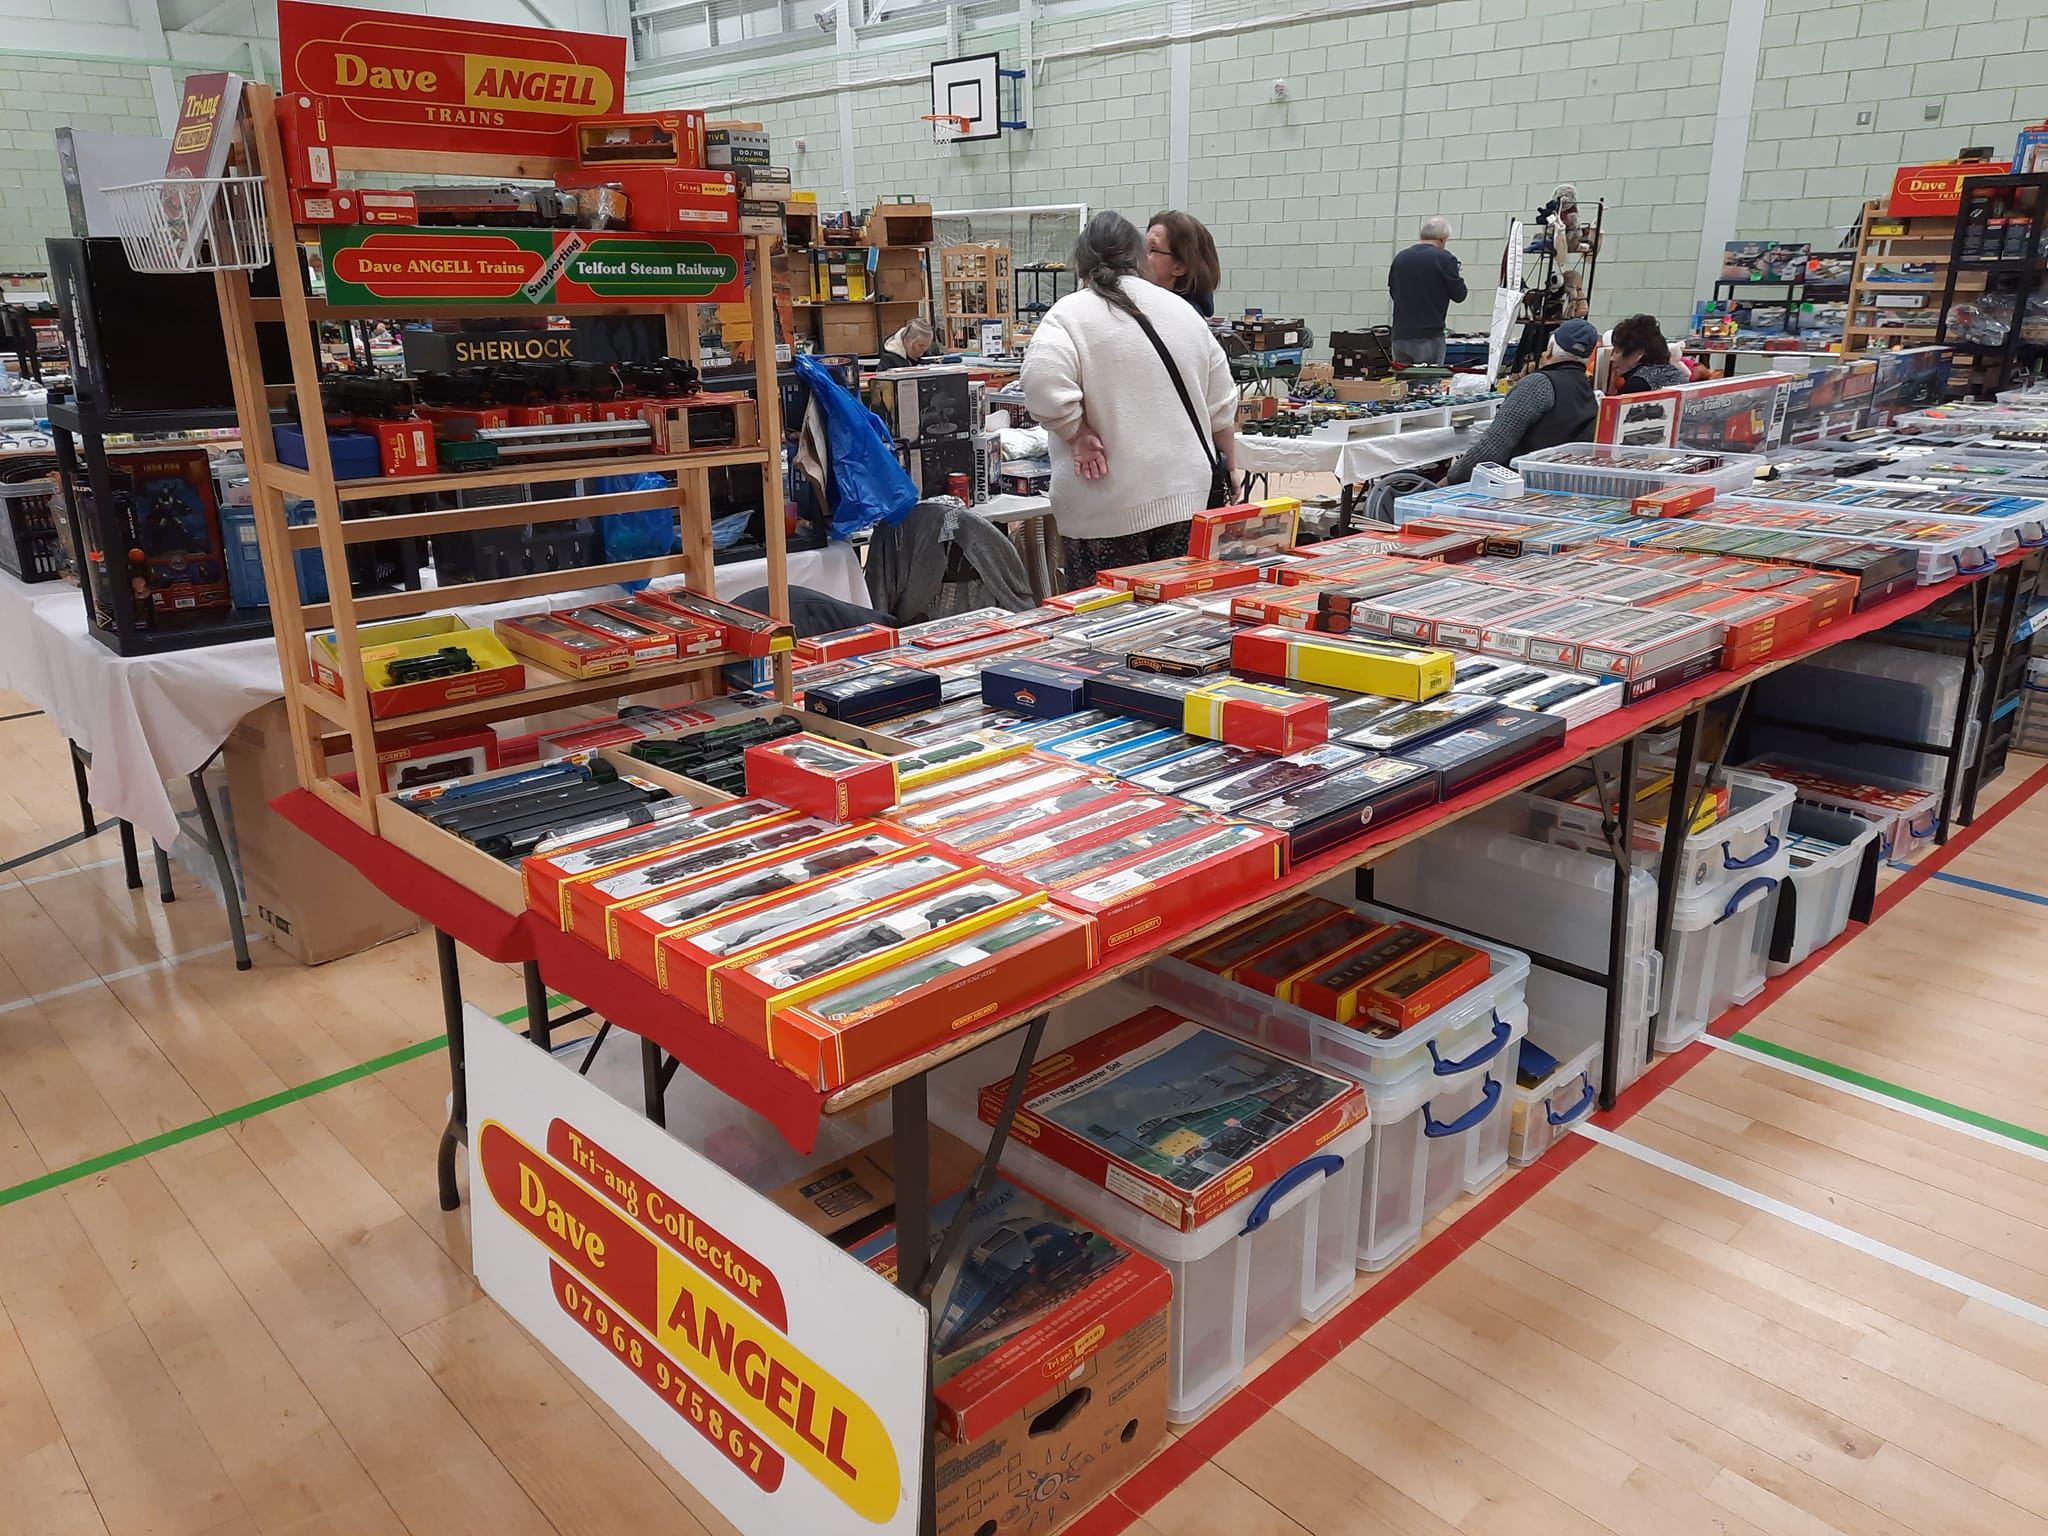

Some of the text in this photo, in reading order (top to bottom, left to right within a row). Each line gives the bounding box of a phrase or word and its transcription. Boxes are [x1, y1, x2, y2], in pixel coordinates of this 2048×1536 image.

[335, 53, 597, 106] Dave ANGELL
[425, 107, 504, 125] TRAINS
[1910, 180, 1946, 191] Dave
[359, 259, 525, 274] Dave ANGELL Trains
[527, 238, 582, 297] Supporting
[576, 262, 726, 277] Telford Steam Railway
[455, 339, 574, 361] SHERLOCK
[976, 449, 985, 494] RINTRAH
[1640, 678, 1656, 695] LIMA
[1051, 1067, 1107, 1099] Freightmaster
[1106, 1060, 1122, 1073] Set
[519, 1161, 605, 1268] Dave
[568, 1132, 761, 1298] Tri-ang Collector
[1205, 1200, 1225, 1219] SCALE
[565, 1283, 763, 1474] 07968 975867
[668, 1286, 857, 1482] ANGELL
